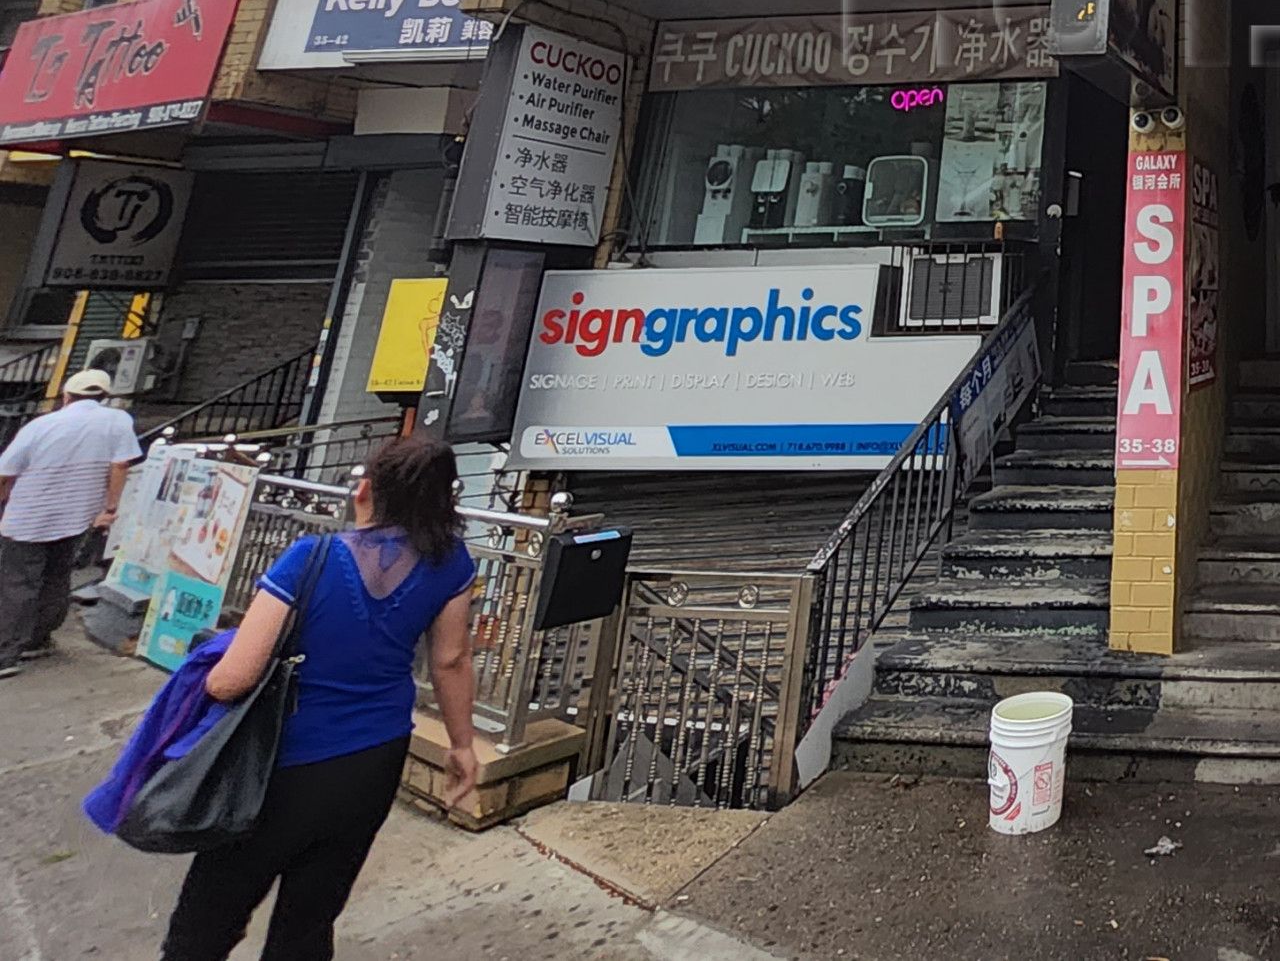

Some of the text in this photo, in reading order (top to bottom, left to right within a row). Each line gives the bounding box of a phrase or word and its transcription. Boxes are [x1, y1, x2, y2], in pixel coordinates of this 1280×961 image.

[313, 35, 349, 46] 35-42
[398, 16, 495, 44] 凯莉 美容
[530, 41, 621, 85] CUCKOO
[655, 17, 1059, 83] 쿠쿠 CUCKOO 정수기 净水器
[532, 72, 618, 106] Water Purifier
[525, 93, 595, 120] Air Purifier
[521, 113, 611, 145] Massage Chair
[513, 147, 569, 174] 净水器
[1135, 154, 1178, 170] GALAXY
[508, 175, 596, 204] 空气净化器
[1132, 172, 1182, 191] 银河会所
[504, 202, 590, 231] 智能按摩椅
[539, 288, 864, 358] signgraphics
[1122, 203, 1174, 416] SPA
[529, 371, 856, 389] SIGNAGE PRINT DISPLAY DESIGN WEB
[561, 446, 611, 455] SOLUTIONS
[1119, 438, 1176, 454] 35-38
